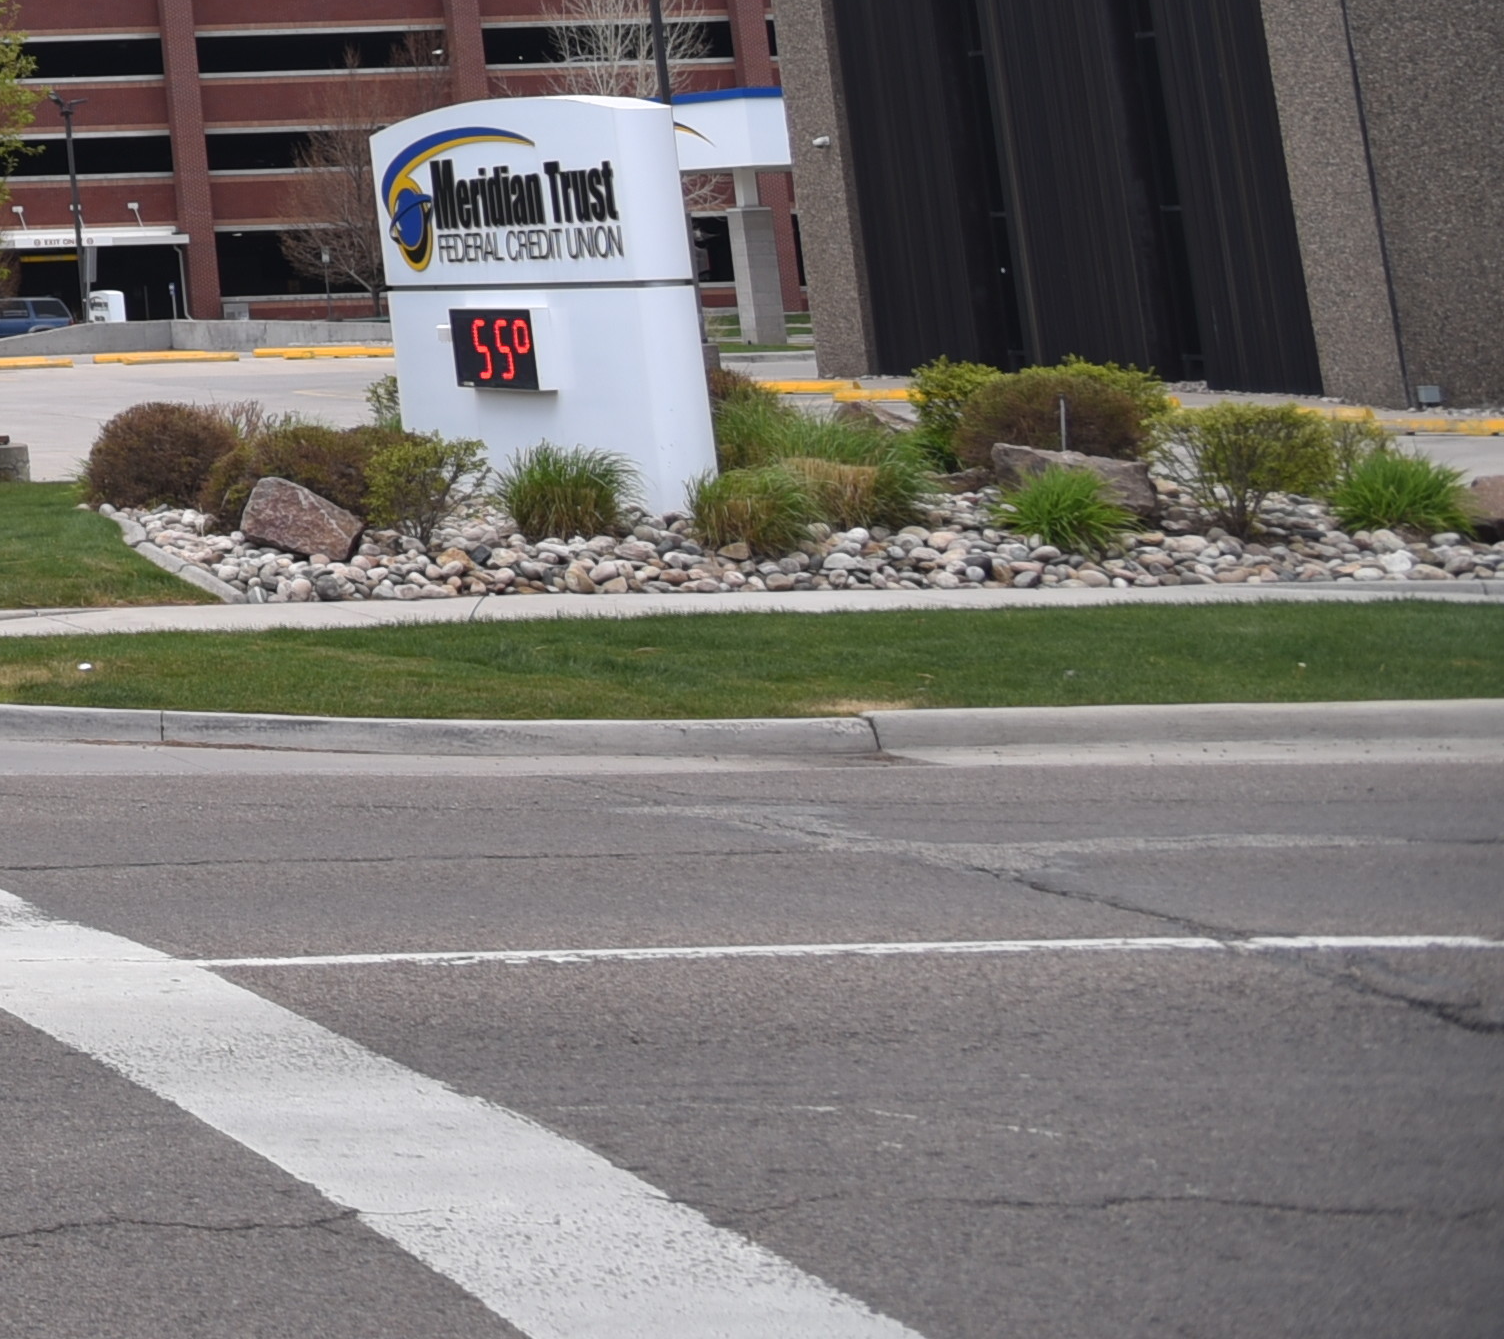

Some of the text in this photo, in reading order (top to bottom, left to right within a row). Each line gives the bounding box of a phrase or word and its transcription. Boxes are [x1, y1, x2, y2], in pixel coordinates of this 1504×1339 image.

[430, 159, 620, 231] Meridian Trust
[438, 225, 625, 263] FEDERAL CREDIT UNION
